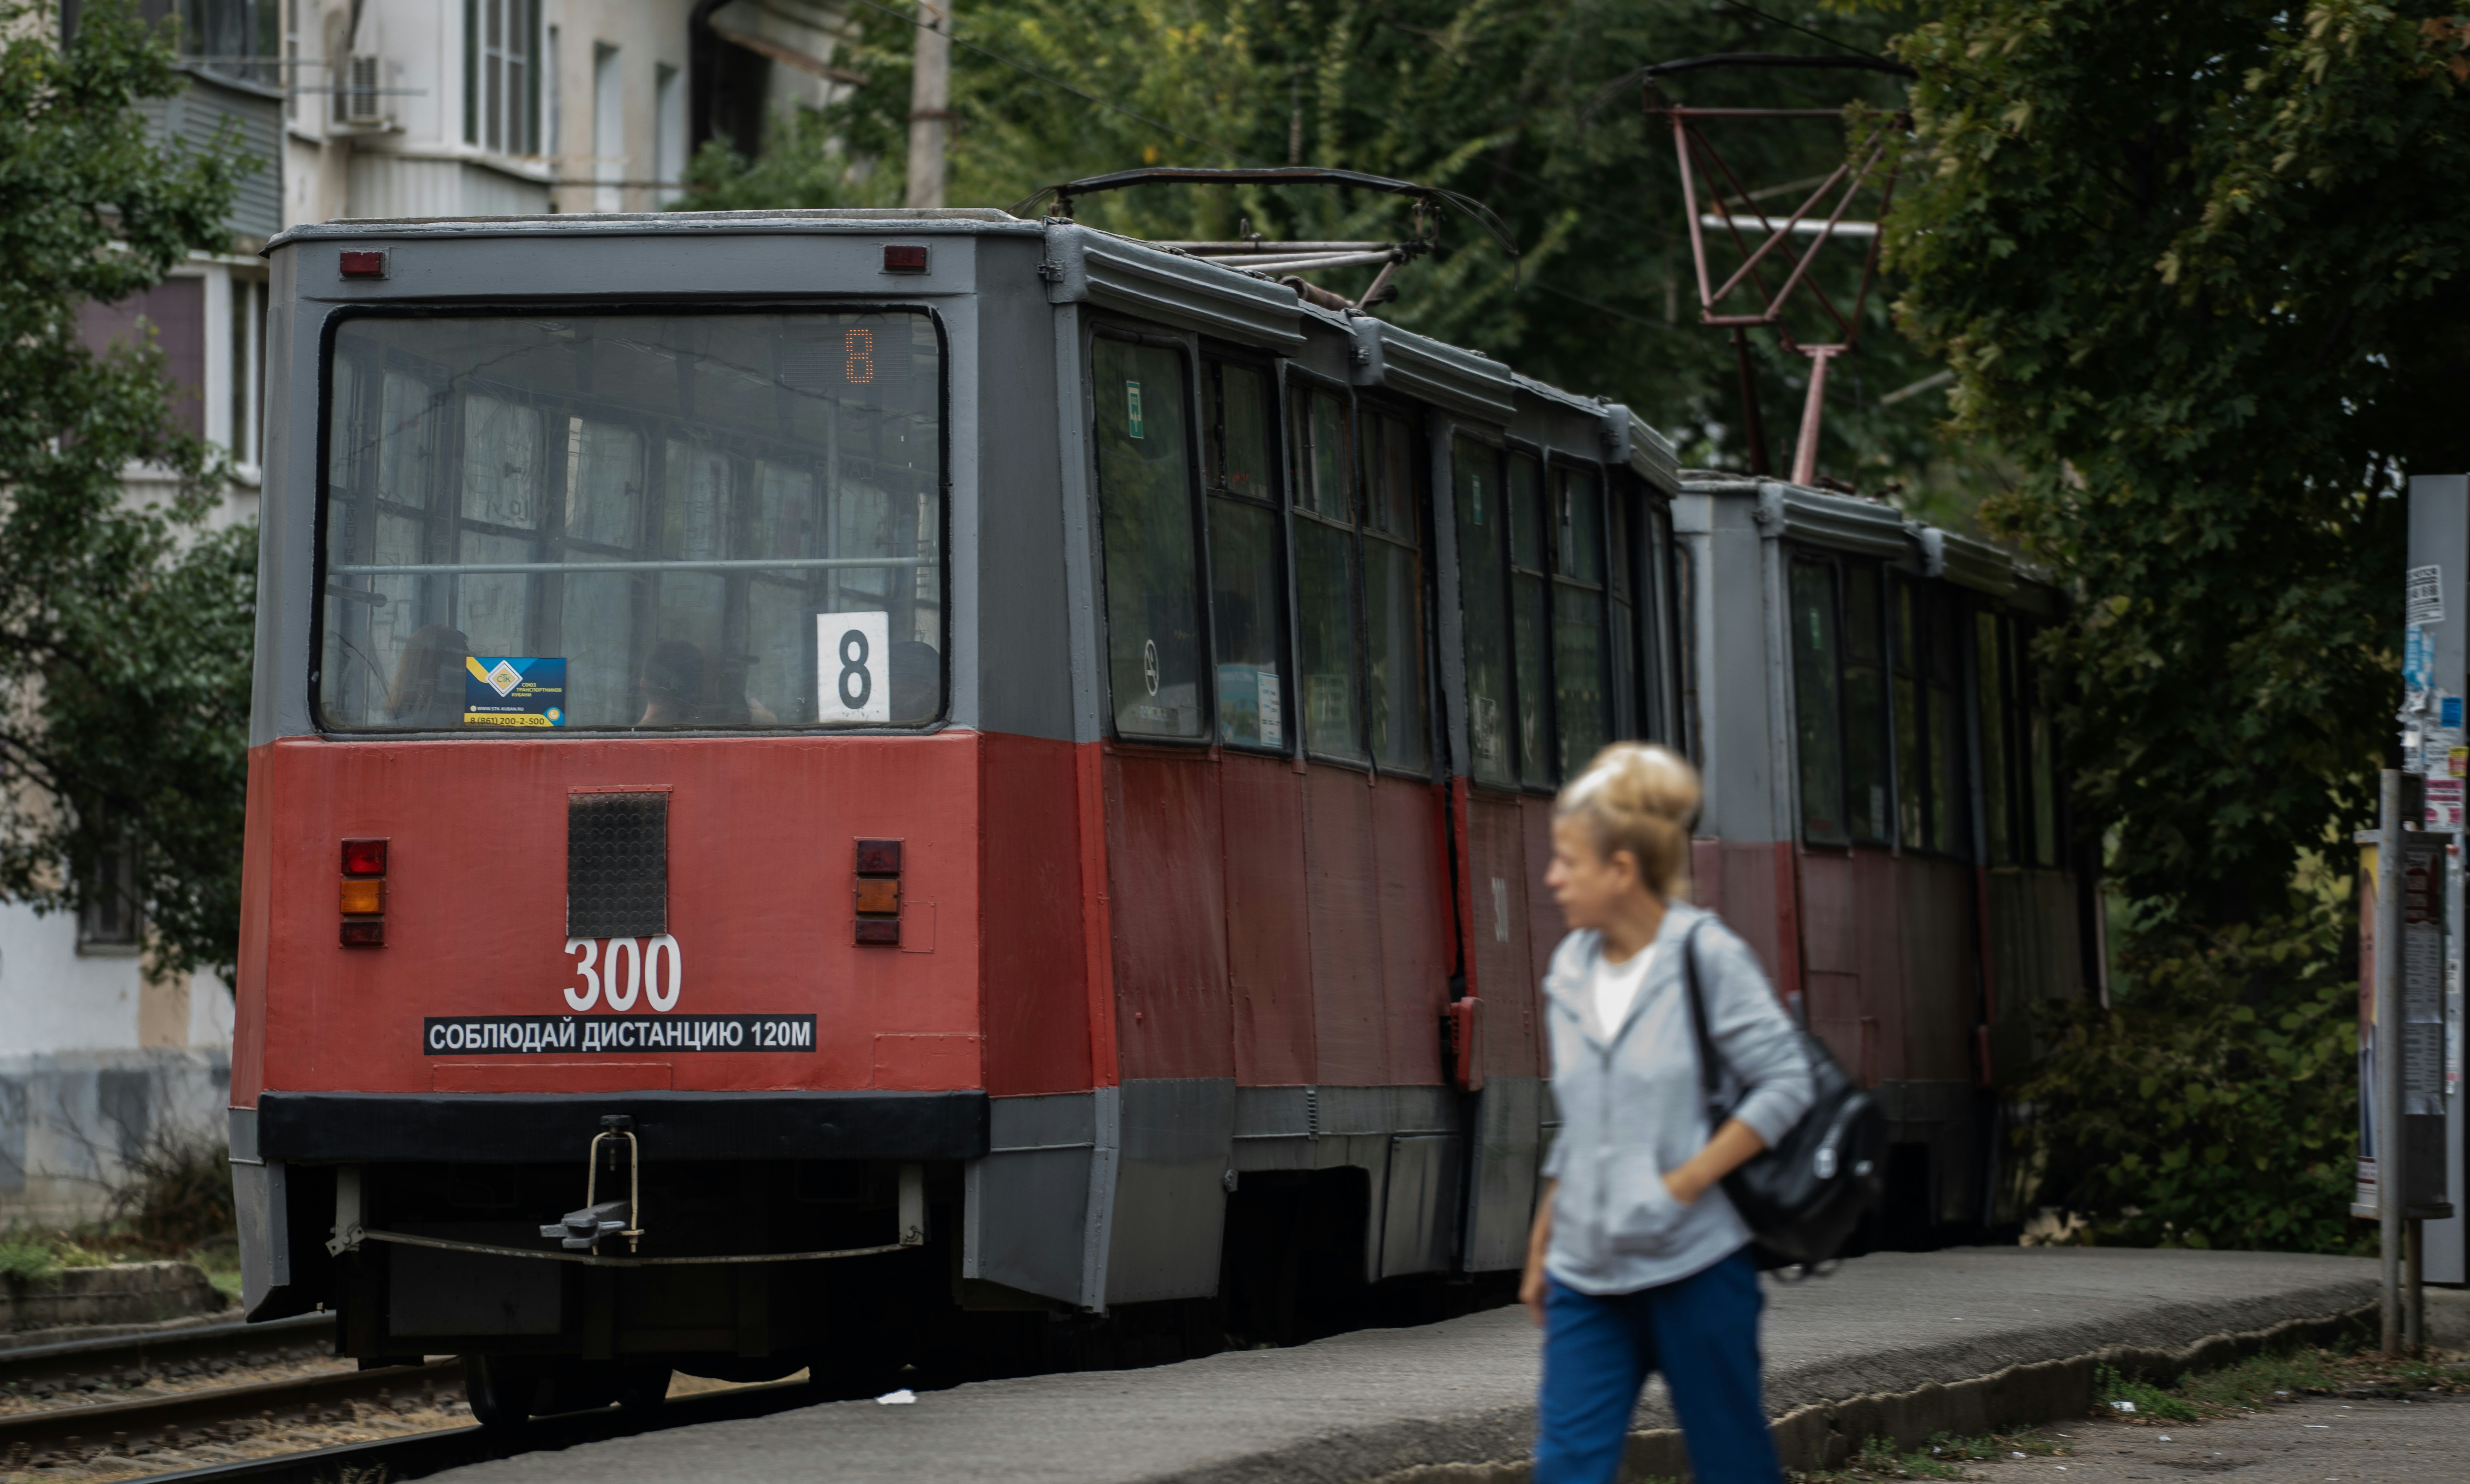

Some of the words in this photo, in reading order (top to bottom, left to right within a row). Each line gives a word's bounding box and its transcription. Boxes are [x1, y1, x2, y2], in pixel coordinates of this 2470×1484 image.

[846, 330, 873, 383] 8
[839, 629, 871, 709] 8
[563, 934, 681, 1012] 300
[429, 1017, 576, 1052] СОБЛЮДАЙ
[581, 1022, 743, 1051] ДИСТАНЦИЮ
[751, 1022, 811, 1046] 120М
